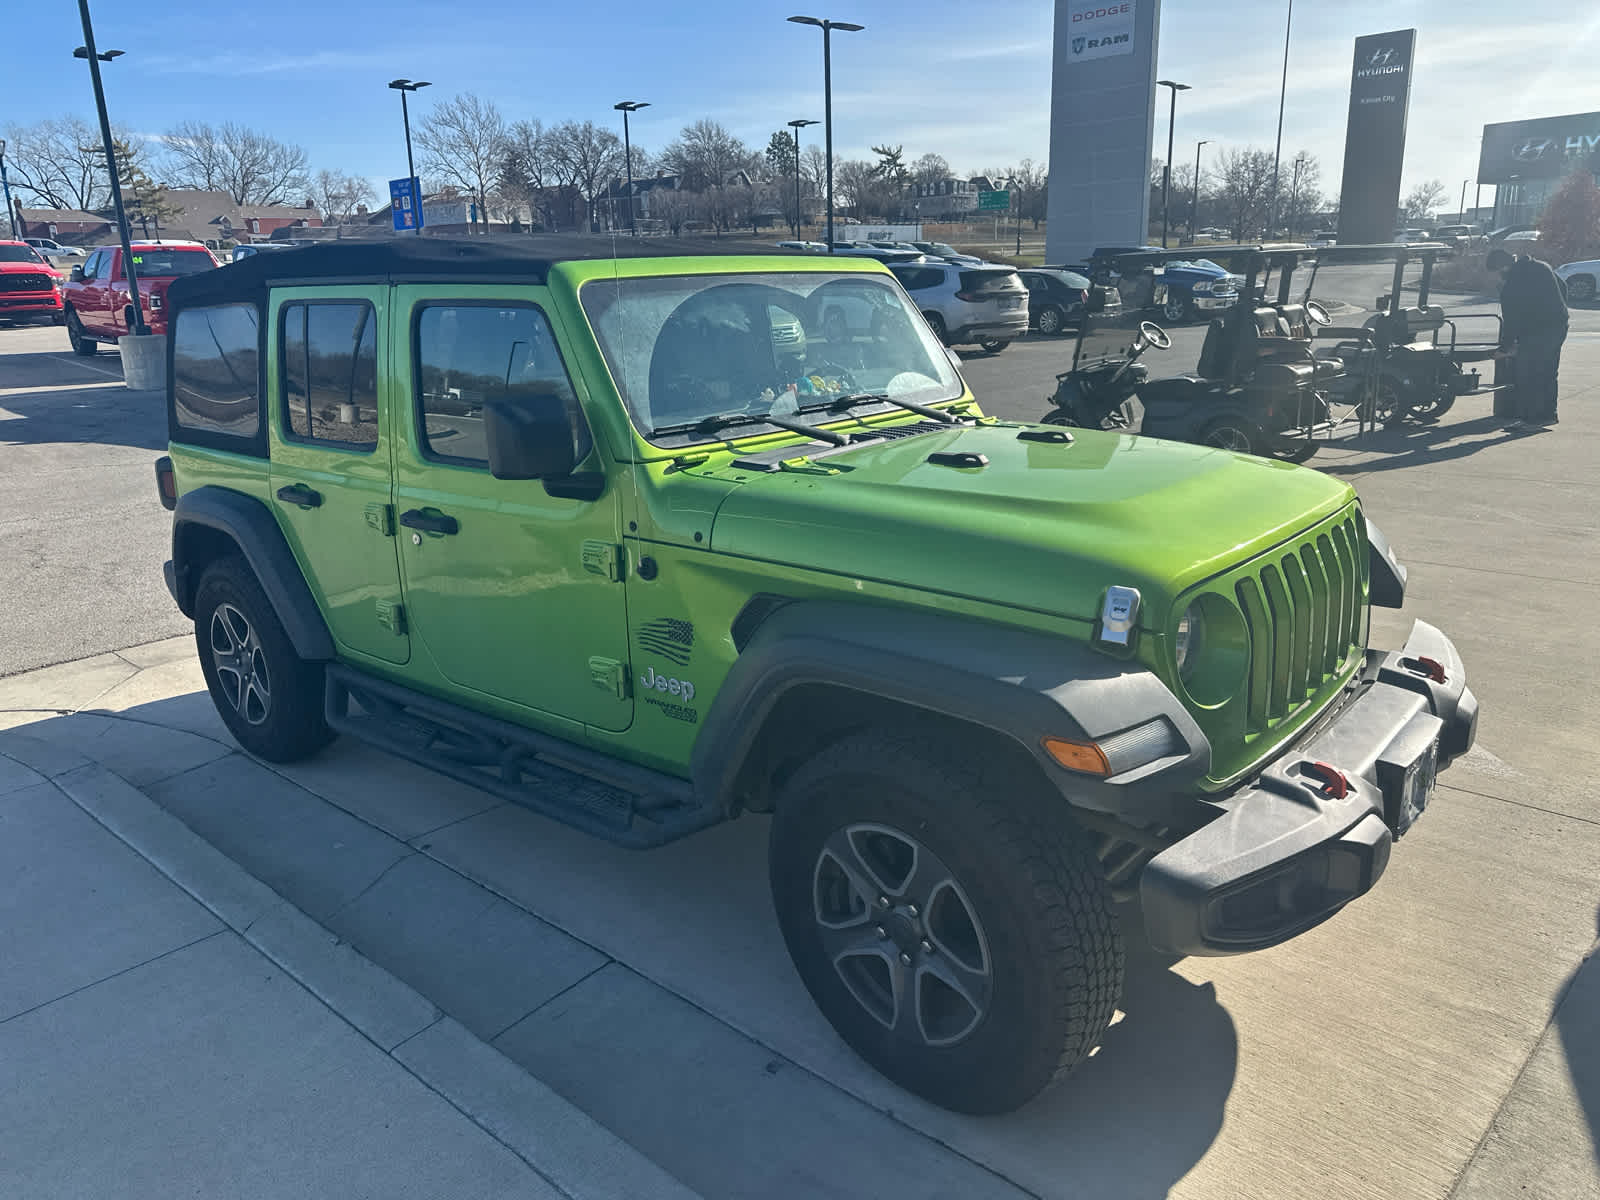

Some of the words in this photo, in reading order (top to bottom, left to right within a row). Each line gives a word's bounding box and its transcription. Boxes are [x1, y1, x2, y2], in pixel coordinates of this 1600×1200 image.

[1072, 4, 1129, 23] DODGE
[1087, 33, 1129, 49] RAM
[1358, 64, 1404, 78] HYUNDAI
[640, 666, 695, 703] Jeep
